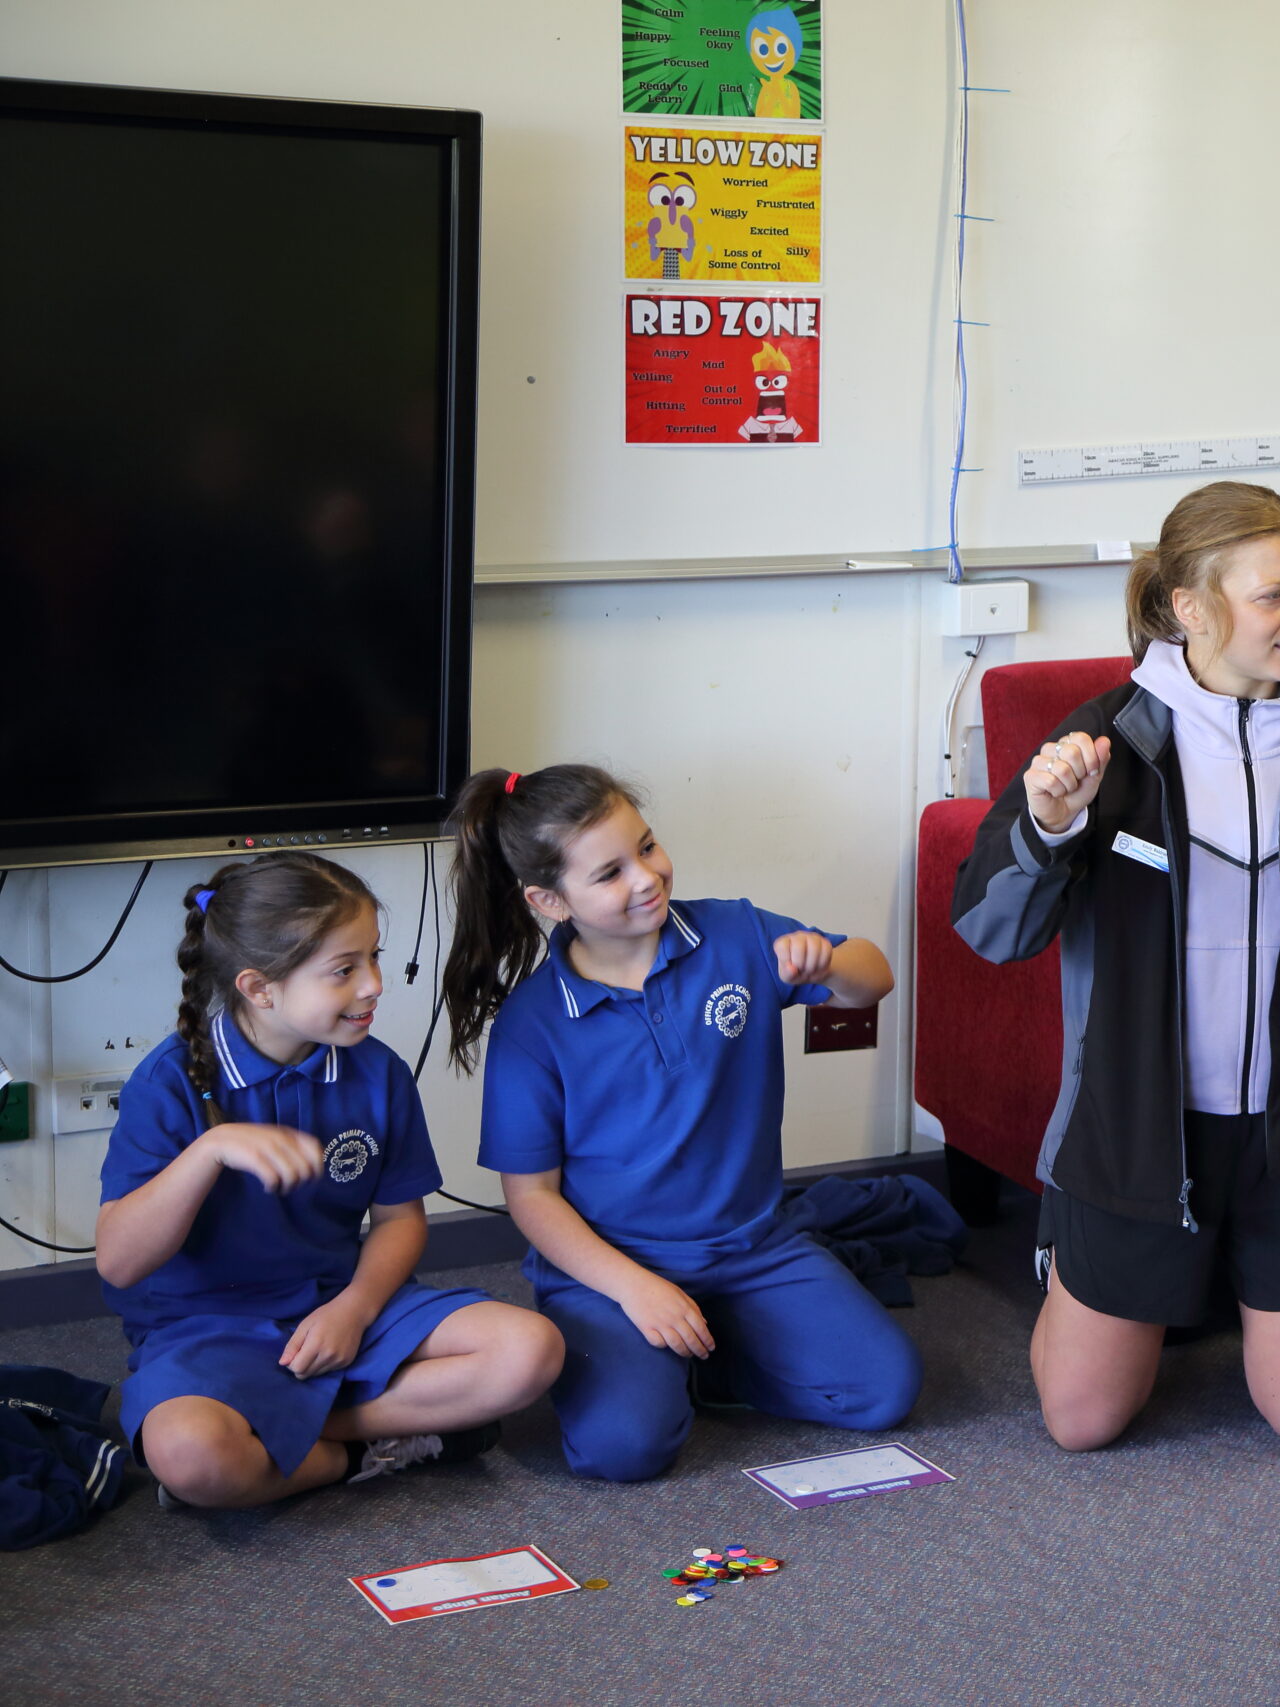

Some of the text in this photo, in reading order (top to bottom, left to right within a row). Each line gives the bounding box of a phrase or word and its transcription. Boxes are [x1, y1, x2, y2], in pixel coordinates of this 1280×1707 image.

[655, 8, 684, 18] Calm
[635, 32, 671, 43] Happy
[700, 28, 740, 39] Feeling
[707, 40, 733, 51] Okay
[663, 58, 709, 68] Focused
[639, 82, 688, 92] Ready to
[719, 84, 742, 93] Glad
[648, 94, 682, 104] Learn
[630, 135, 818, 168] YELLOW ZONE
[722, 178, 768, 188] Worried
[756, 200, 815, 210] Frustrated
[710, 208, 748, 219] Wiggly
[750, 227, 789, 236] Excited
[724, 249, 762, 258] Loss of
[786, 247, 810, 258] Silly
[708, 260, 780, 270] Some Control
[630, 299, 818, 338] RED ZONE
[653, 349, 690, 359] Angry
[702, 361, 724, 369] Mad
[632, 372, 673, 384] Yelling
[704, 385, 736, 394] Out of
[646, 401, 686, 412] Hitting
[702, 397, 742, 406] Control
[666, 425, 717, 433] Terrified
[710, 984, 733, 1000] PRIMARY
[339, 1129, 365, 1141] PRIMARY
[364, 1135, 379, 1156] SCHOOL
